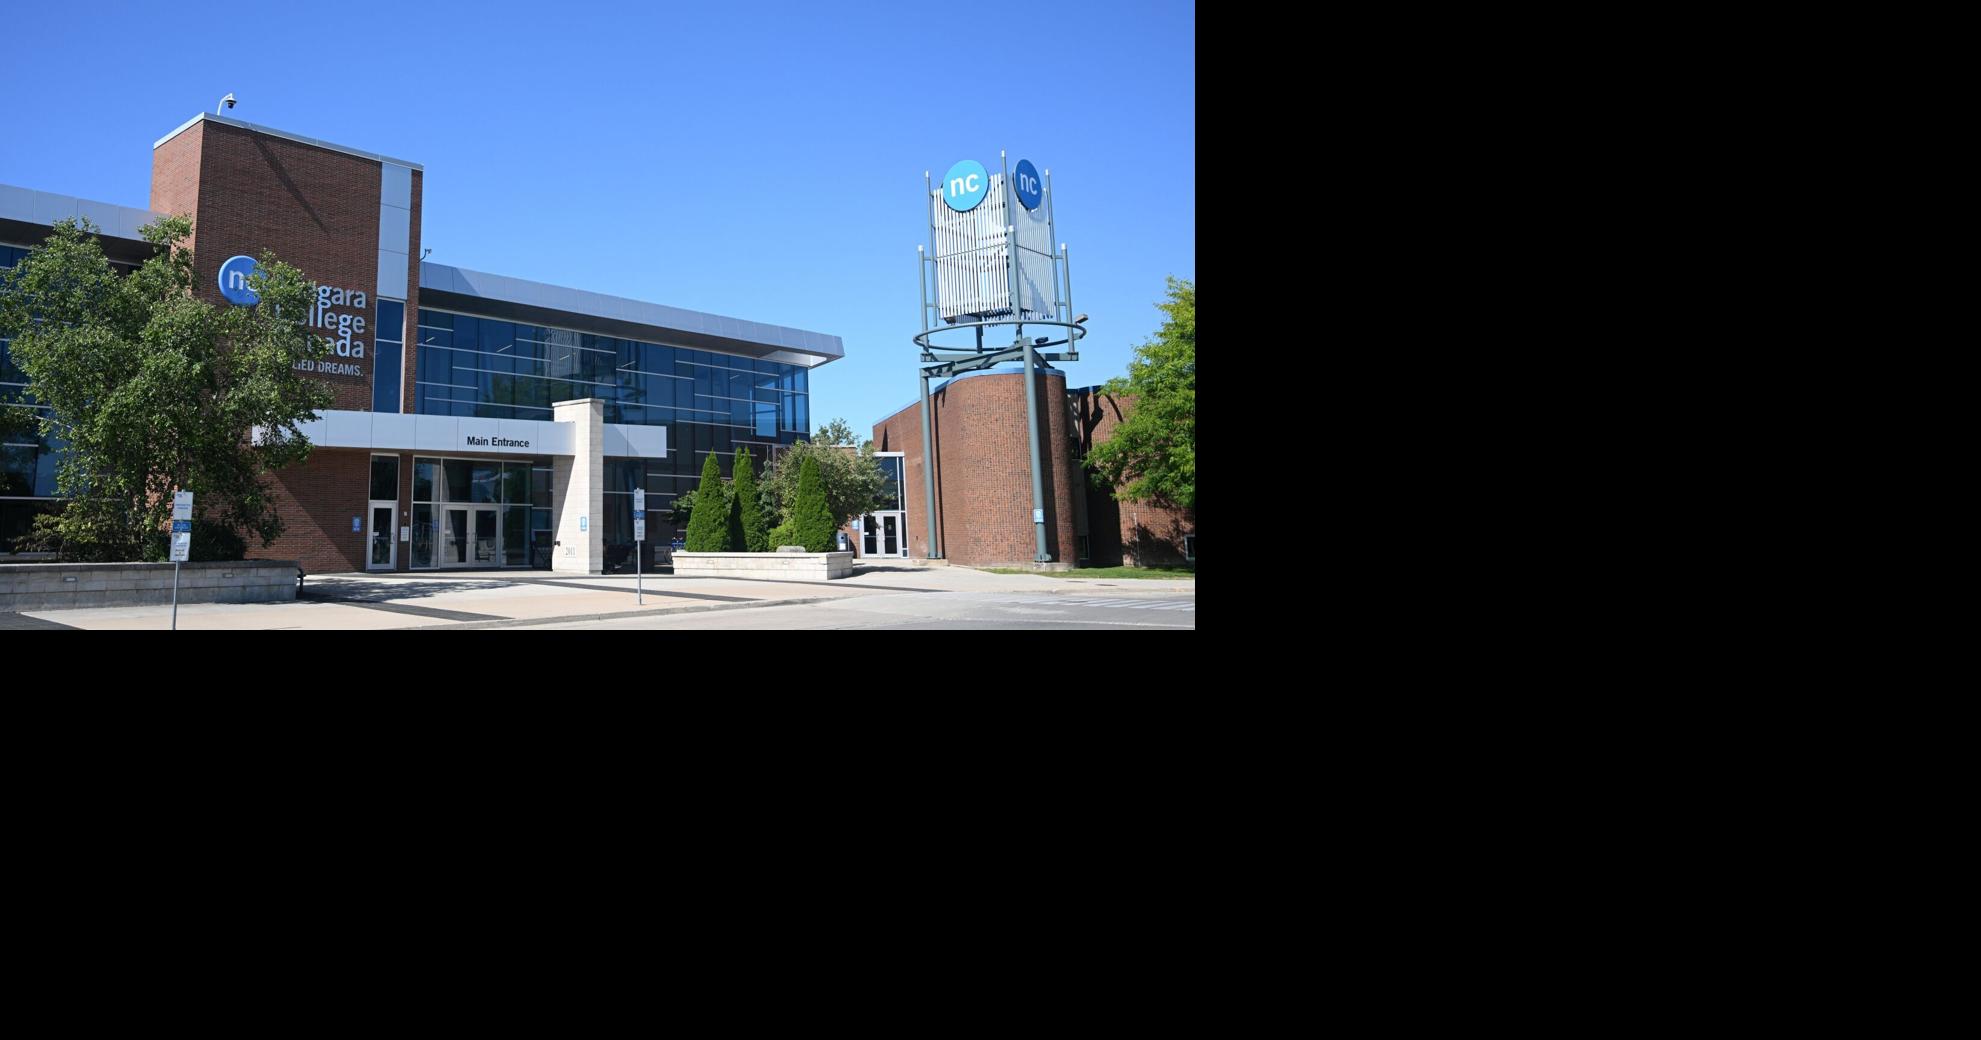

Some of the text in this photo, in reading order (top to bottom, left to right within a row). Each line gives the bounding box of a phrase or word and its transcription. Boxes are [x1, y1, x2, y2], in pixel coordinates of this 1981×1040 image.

[950, 173, 980, 198] nc
[1020, 173, 1038, 195] nc
[317, 361, 364, 377] DREAMS.
[466, 436, 530, 448] Main Entrance
